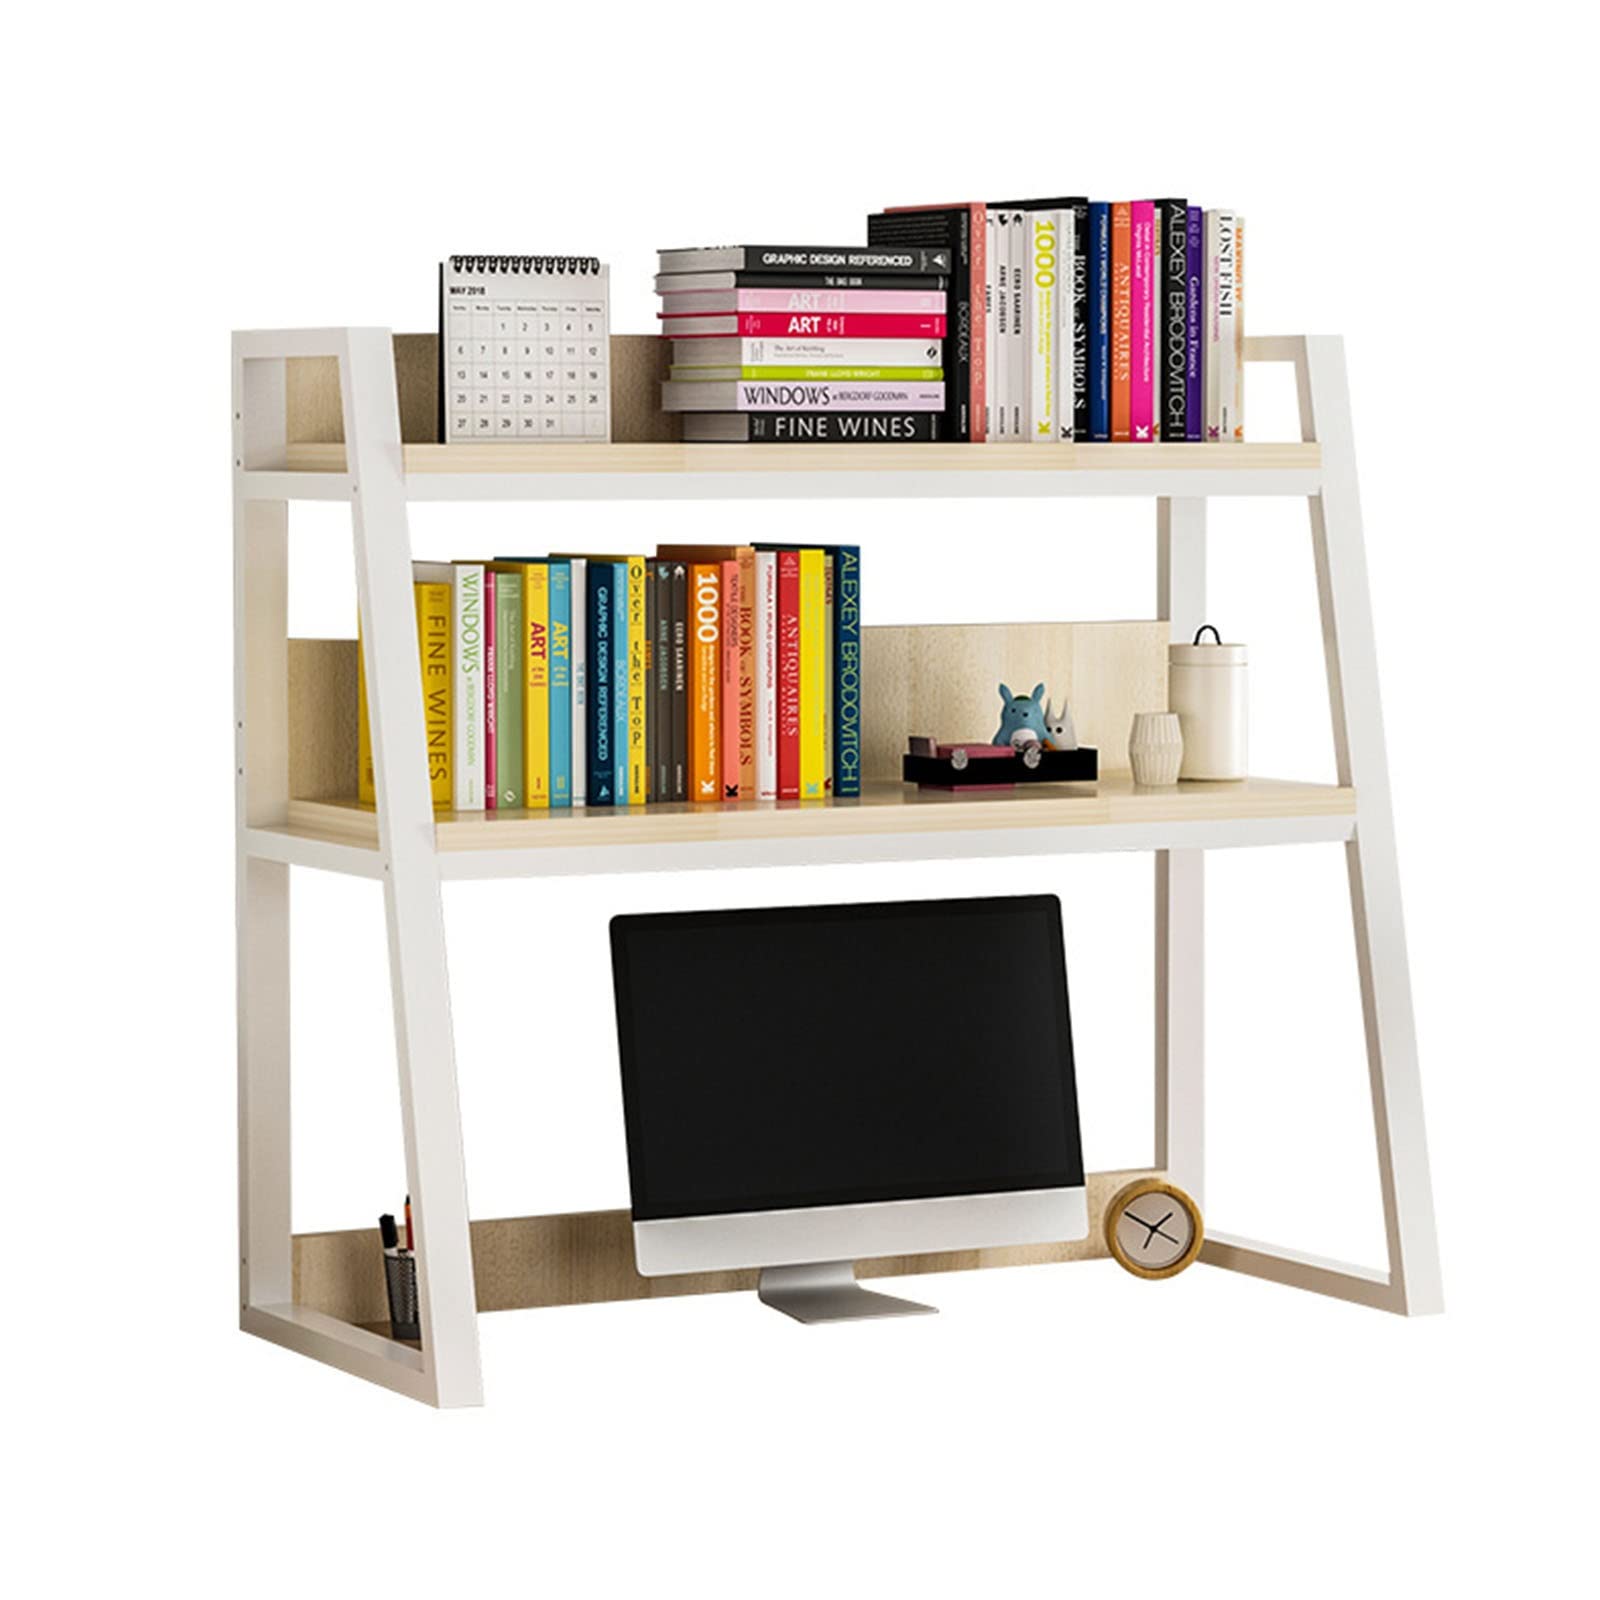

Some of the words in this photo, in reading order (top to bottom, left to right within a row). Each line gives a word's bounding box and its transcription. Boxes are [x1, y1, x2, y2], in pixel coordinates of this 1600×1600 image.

[762, 253, 808, 265] GRAPHIC
[809, 253, 846, 265] DESIGN
[848, 253, 913, 265] REFERENCED
[1035, 220, 1056, 289] 1000
[1169, 204, 1185, 286] ALEXEY
[1219, 215, 1233, 269] LOST
[450, 287, 466, 295] MAY
[467, 287, 485, 295] 2018
[787, 293, 821, 311] ART
[1074, 254, 1086, 303] BOOK
[1189, 275, 1199, 323] Gardens
[1219, 272, 1233, 316] FISH
[787, 316, 821, 334] ART
[959, 301, 968, 363] BORDEAUX
[1117, 261, 1129, 382] ANTIQUAIRES
[1189, 325, 1199, 336] in
[1074, 322, 1086, 409] SYMBOLS
[1169, 291, 1185, 427] BRODOVITCH
[1189, 338, 1199, 378] France
[744, 386, 830, 406] WINDOWS
[775, 416, 828, 438] FINE
[837, 416, 916, 438] WINES
[597, 586, 607, 638] GRAPHIC
[631, 564, 642, 623] Over
[697, 572, 719, 643] 1000
[841, 551, 857, 635] ALEXEY
[428, 614, 447, 676] FINE
[461, 572, 480, 673] WINDOWS
[531, 620, 546, 660] ART
[553, 620, 568, 660] ART
[740, 606, 752, 657] BOOK
[597, 640, 607, 682] DESIGN
[631, 640, 642, 684] the
[785, 614, 798, 737] ANTIQUAIRES
[428, 688, 447, 781] WINES
[597, 685, 607, 761] REFERENCED
[740, 676, 752, 766] SYMBOLS
[841, 641, 857, 781] BRODOVITCH
